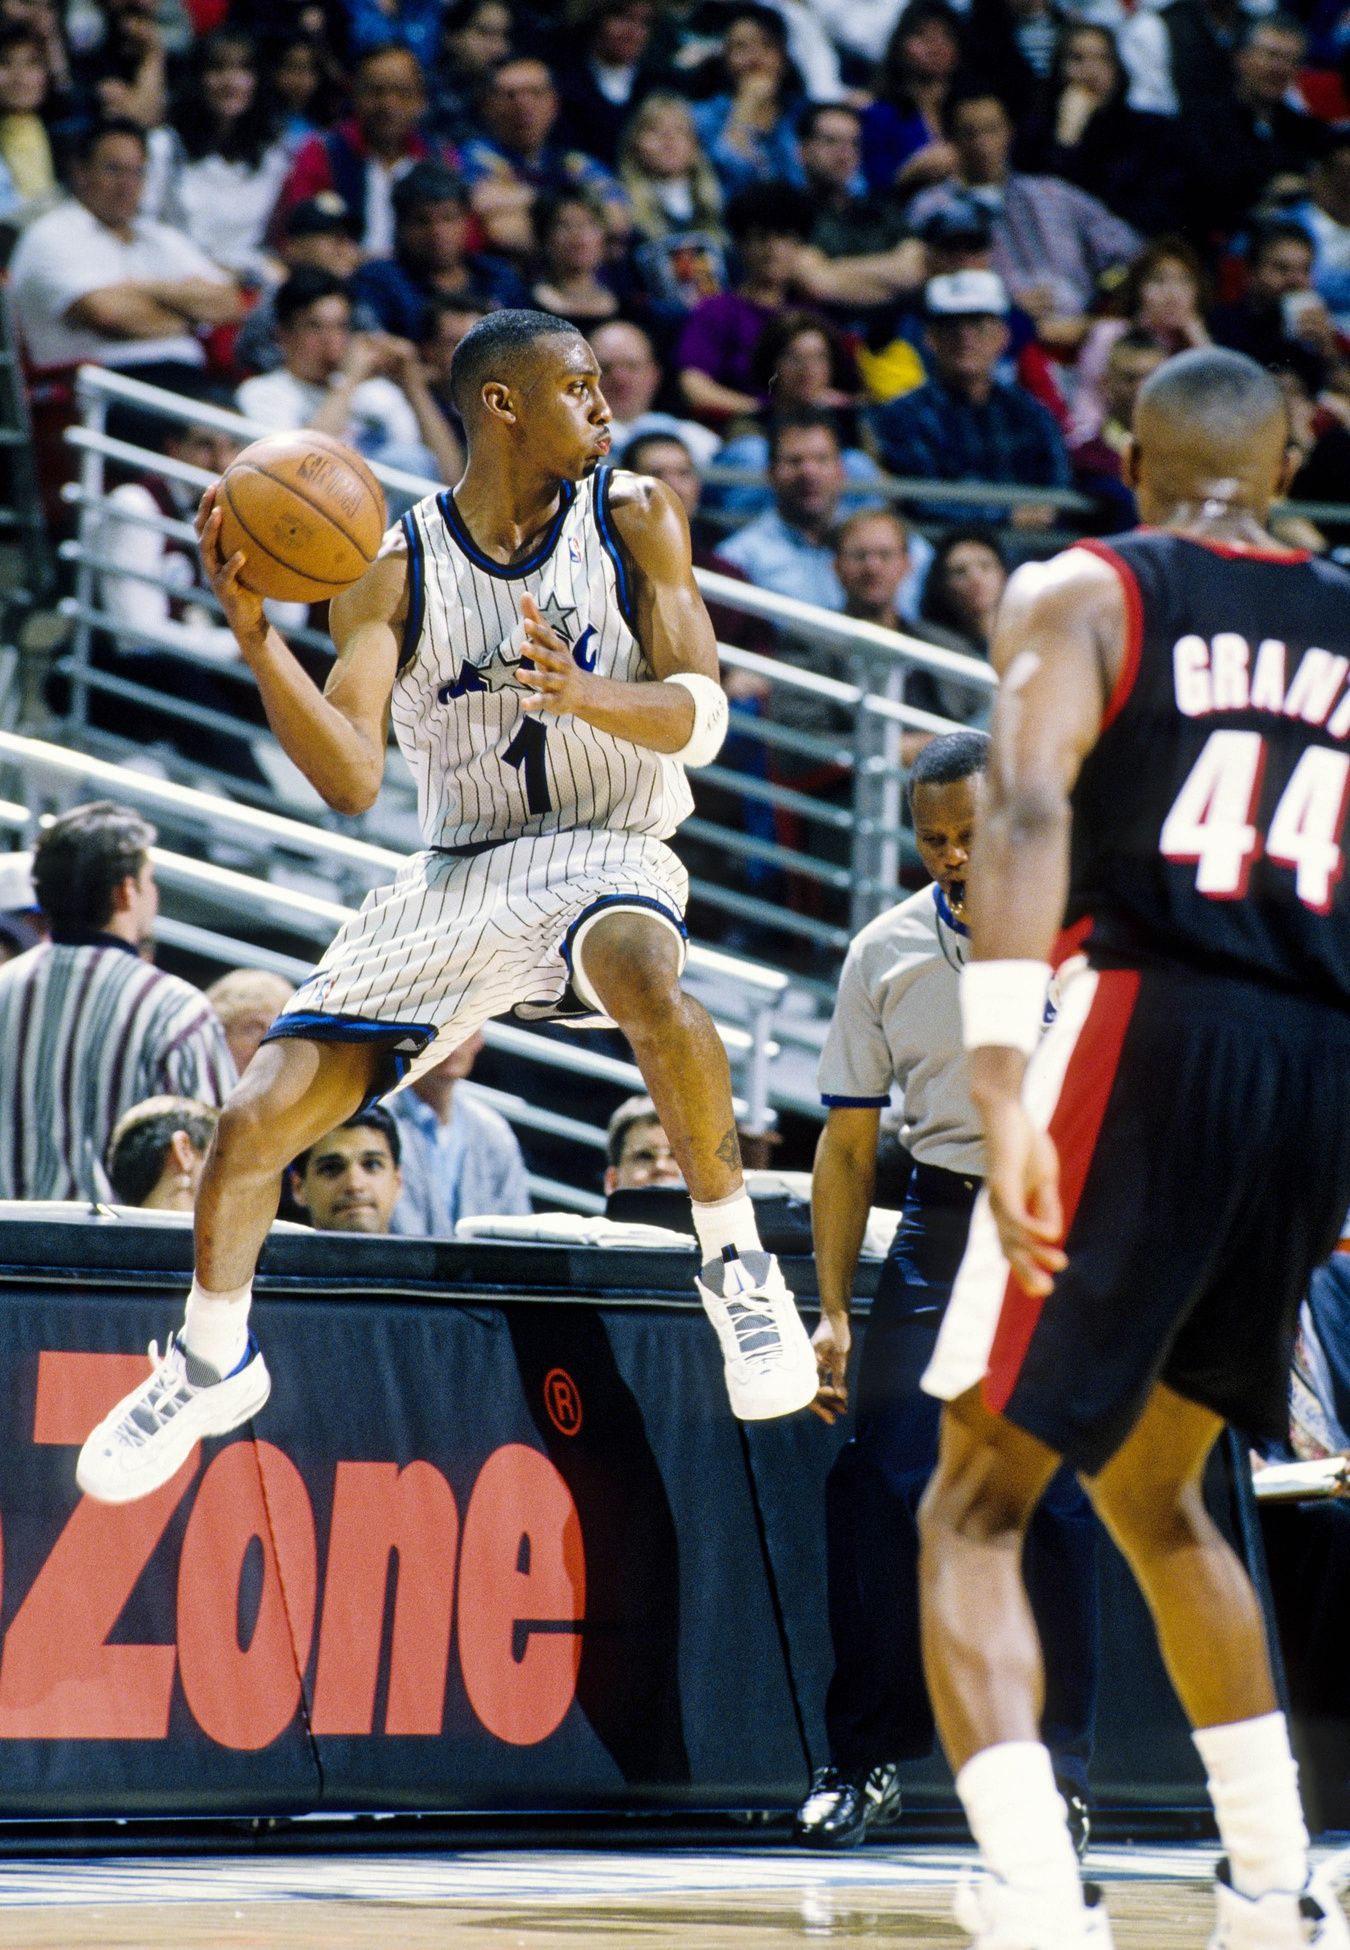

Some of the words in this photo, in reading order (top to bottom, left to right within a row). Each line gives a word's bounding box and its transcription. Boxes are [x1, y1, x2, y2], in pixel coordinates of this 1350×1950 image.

[501, 715, 552, 814] 1
[1159, 729, 1350, 916] 44
[0, 1350, 587, 1750] Zone
